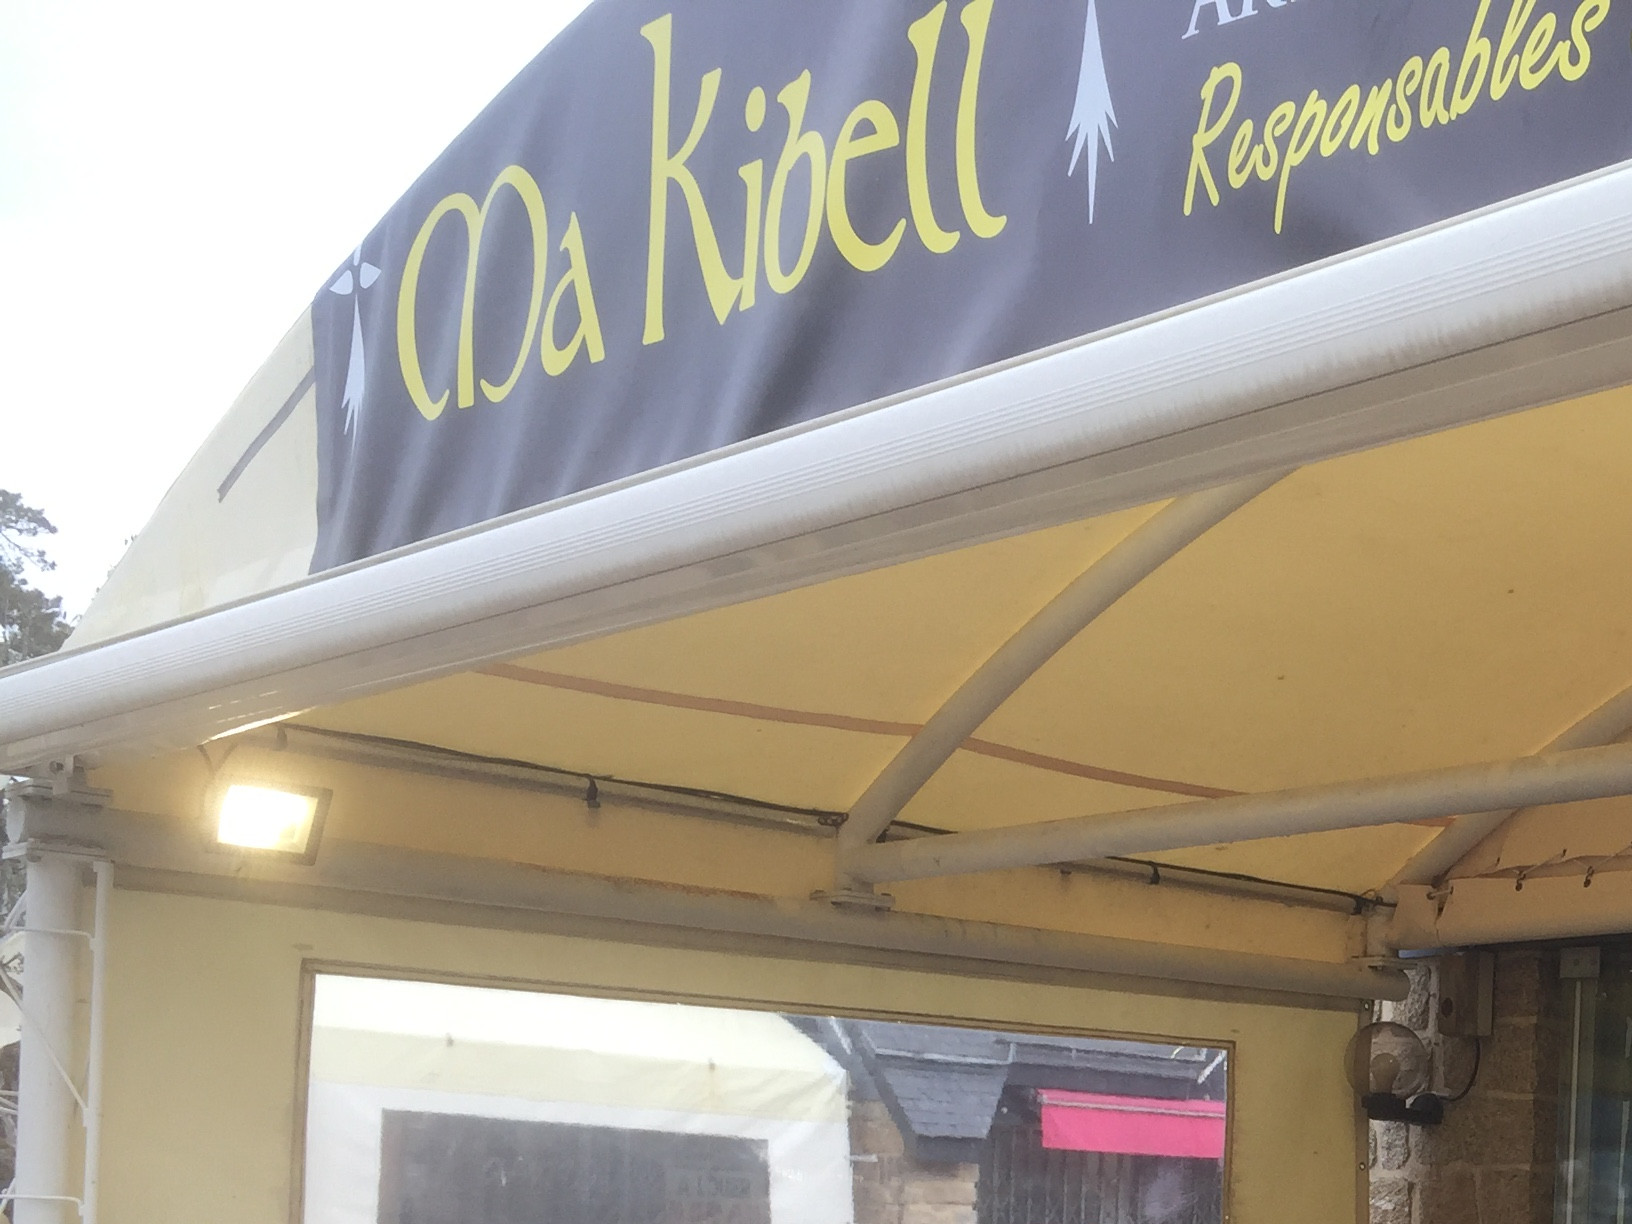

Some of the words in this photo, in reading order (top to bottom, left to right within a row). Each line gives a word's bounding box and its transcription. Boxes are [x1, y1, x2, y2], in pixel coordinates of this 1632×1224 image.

[397, 165, 605, 421] Ma
[640, 0, 1007, 346] Kibell
[1182, 0, 1612, 234] Responsables
